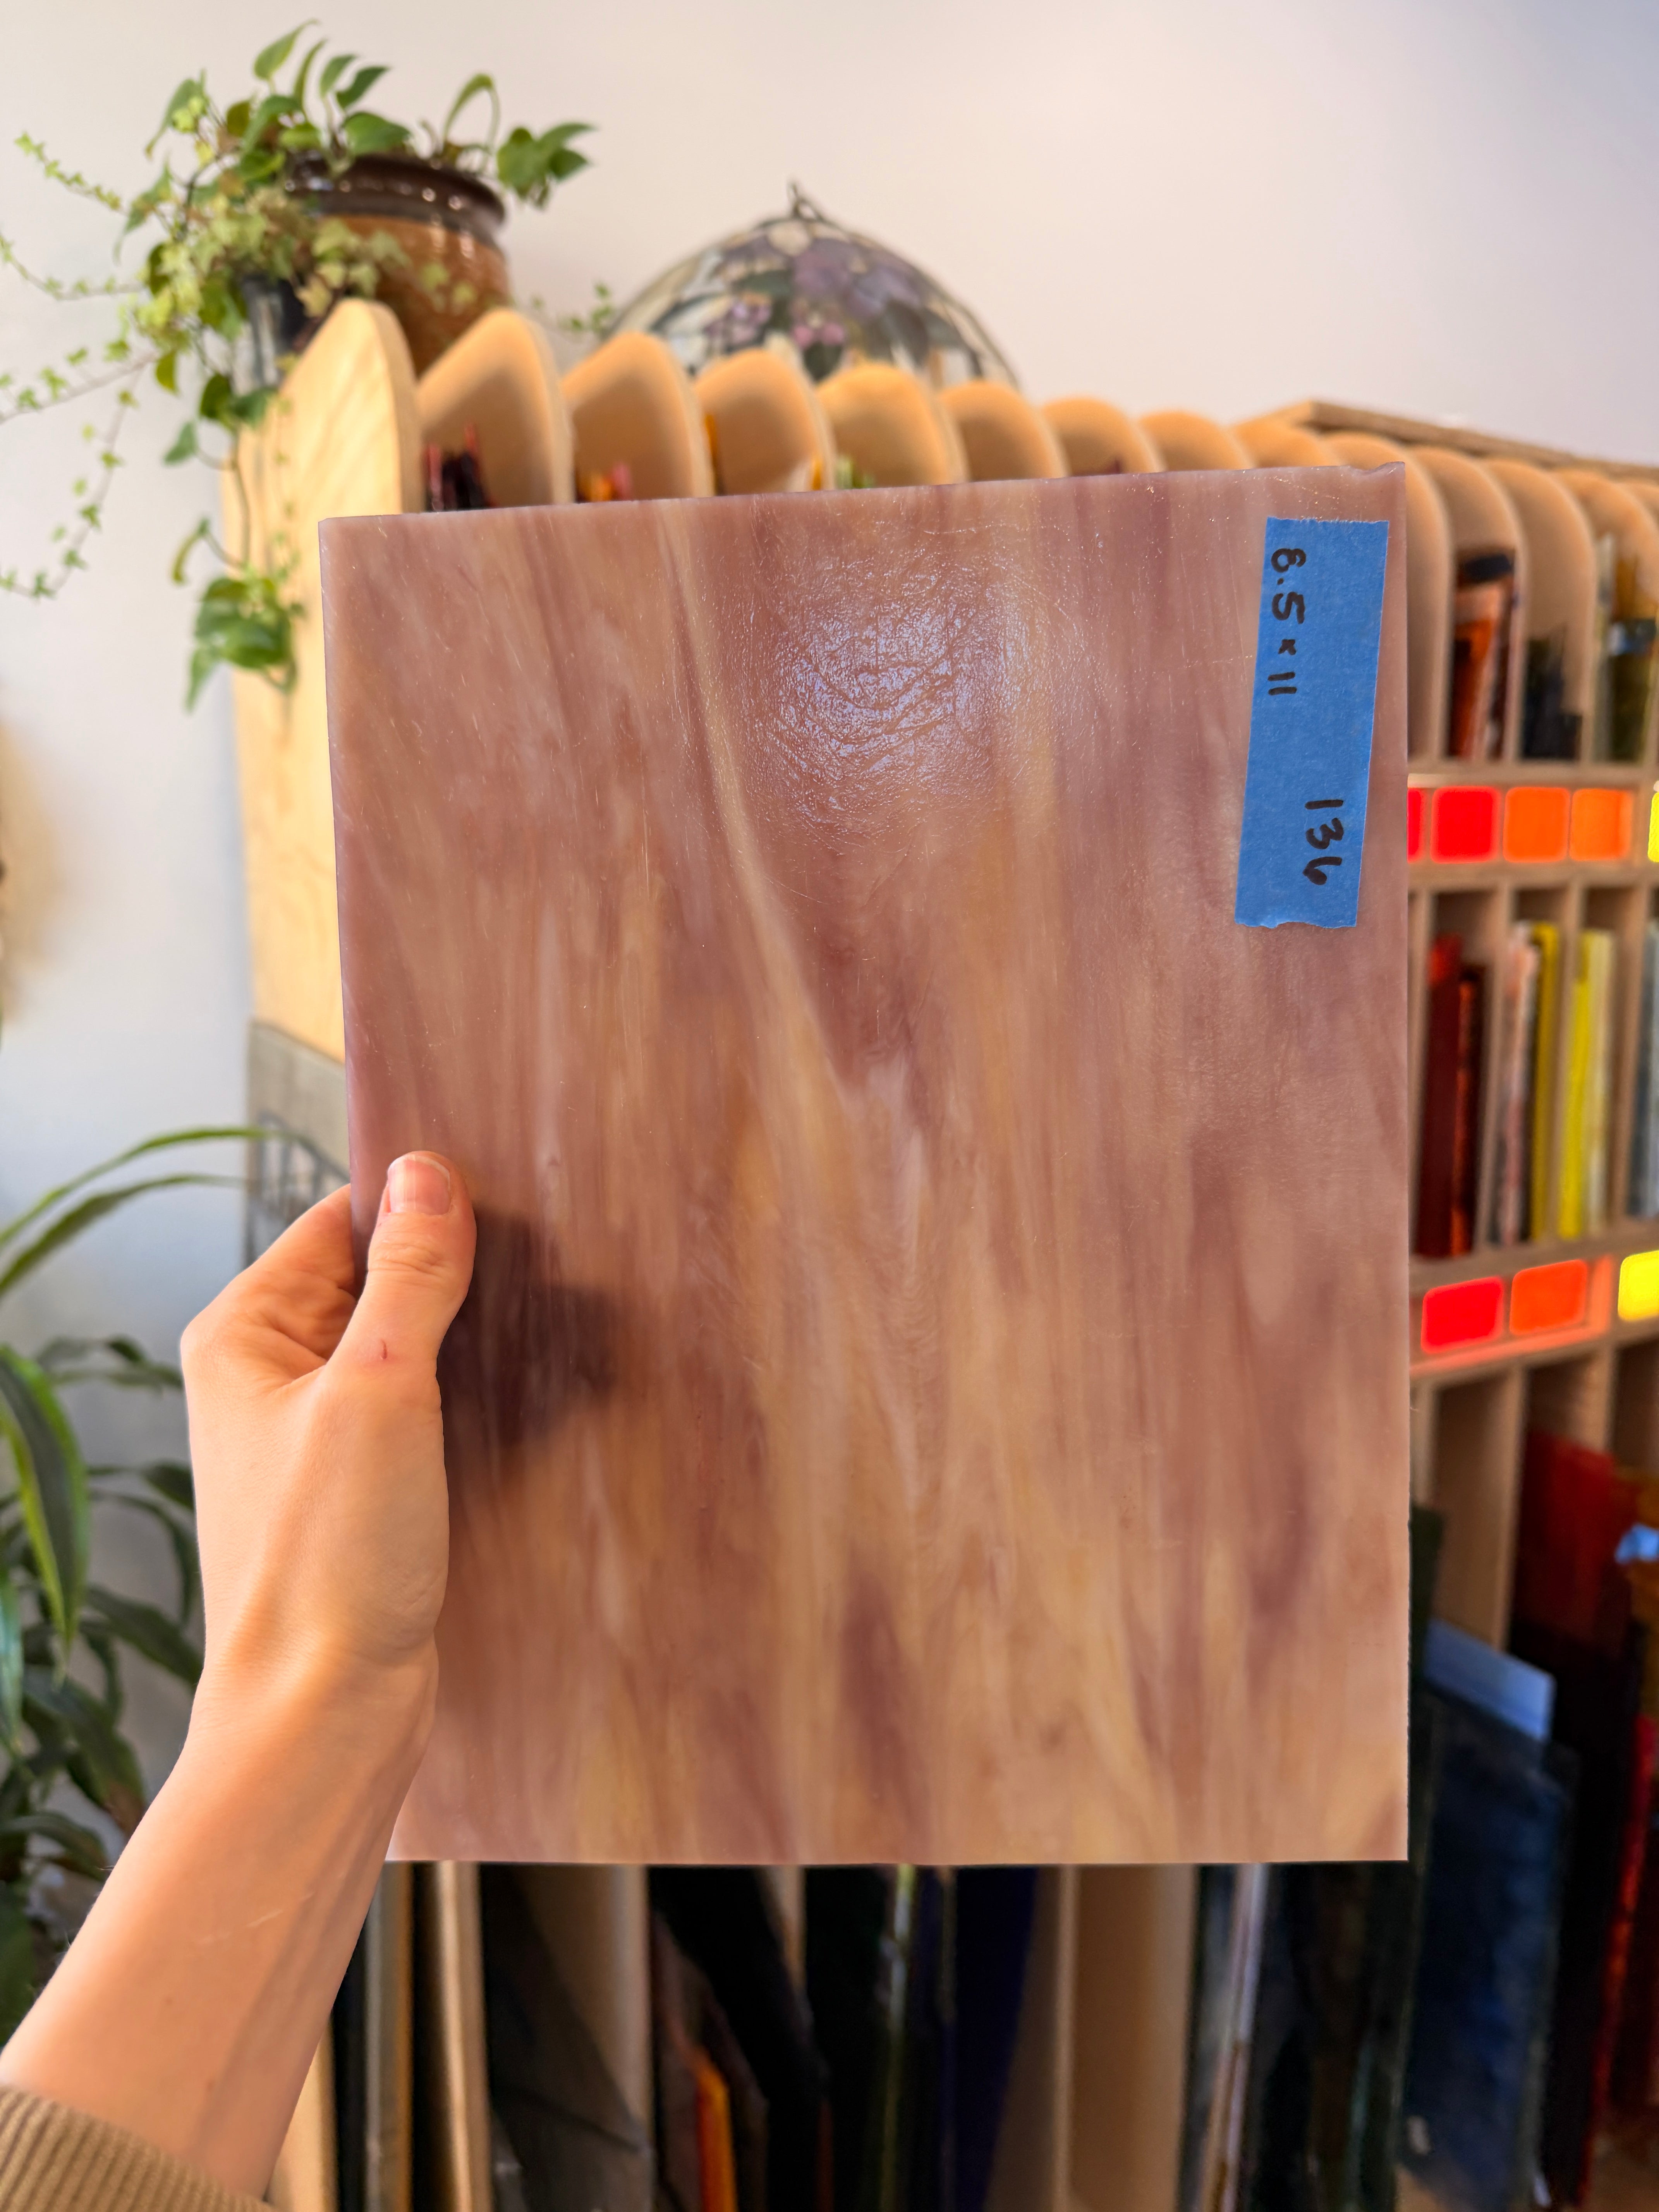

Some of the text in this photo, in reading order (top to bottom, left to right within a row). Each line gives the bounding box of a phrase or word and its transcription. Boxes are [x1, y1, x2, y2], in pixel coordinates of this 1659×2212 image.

[1278, 639, 1297, 656] x
[1267, 671, 1298, 696] 11
[1302, 799, 1345, 886] 136
